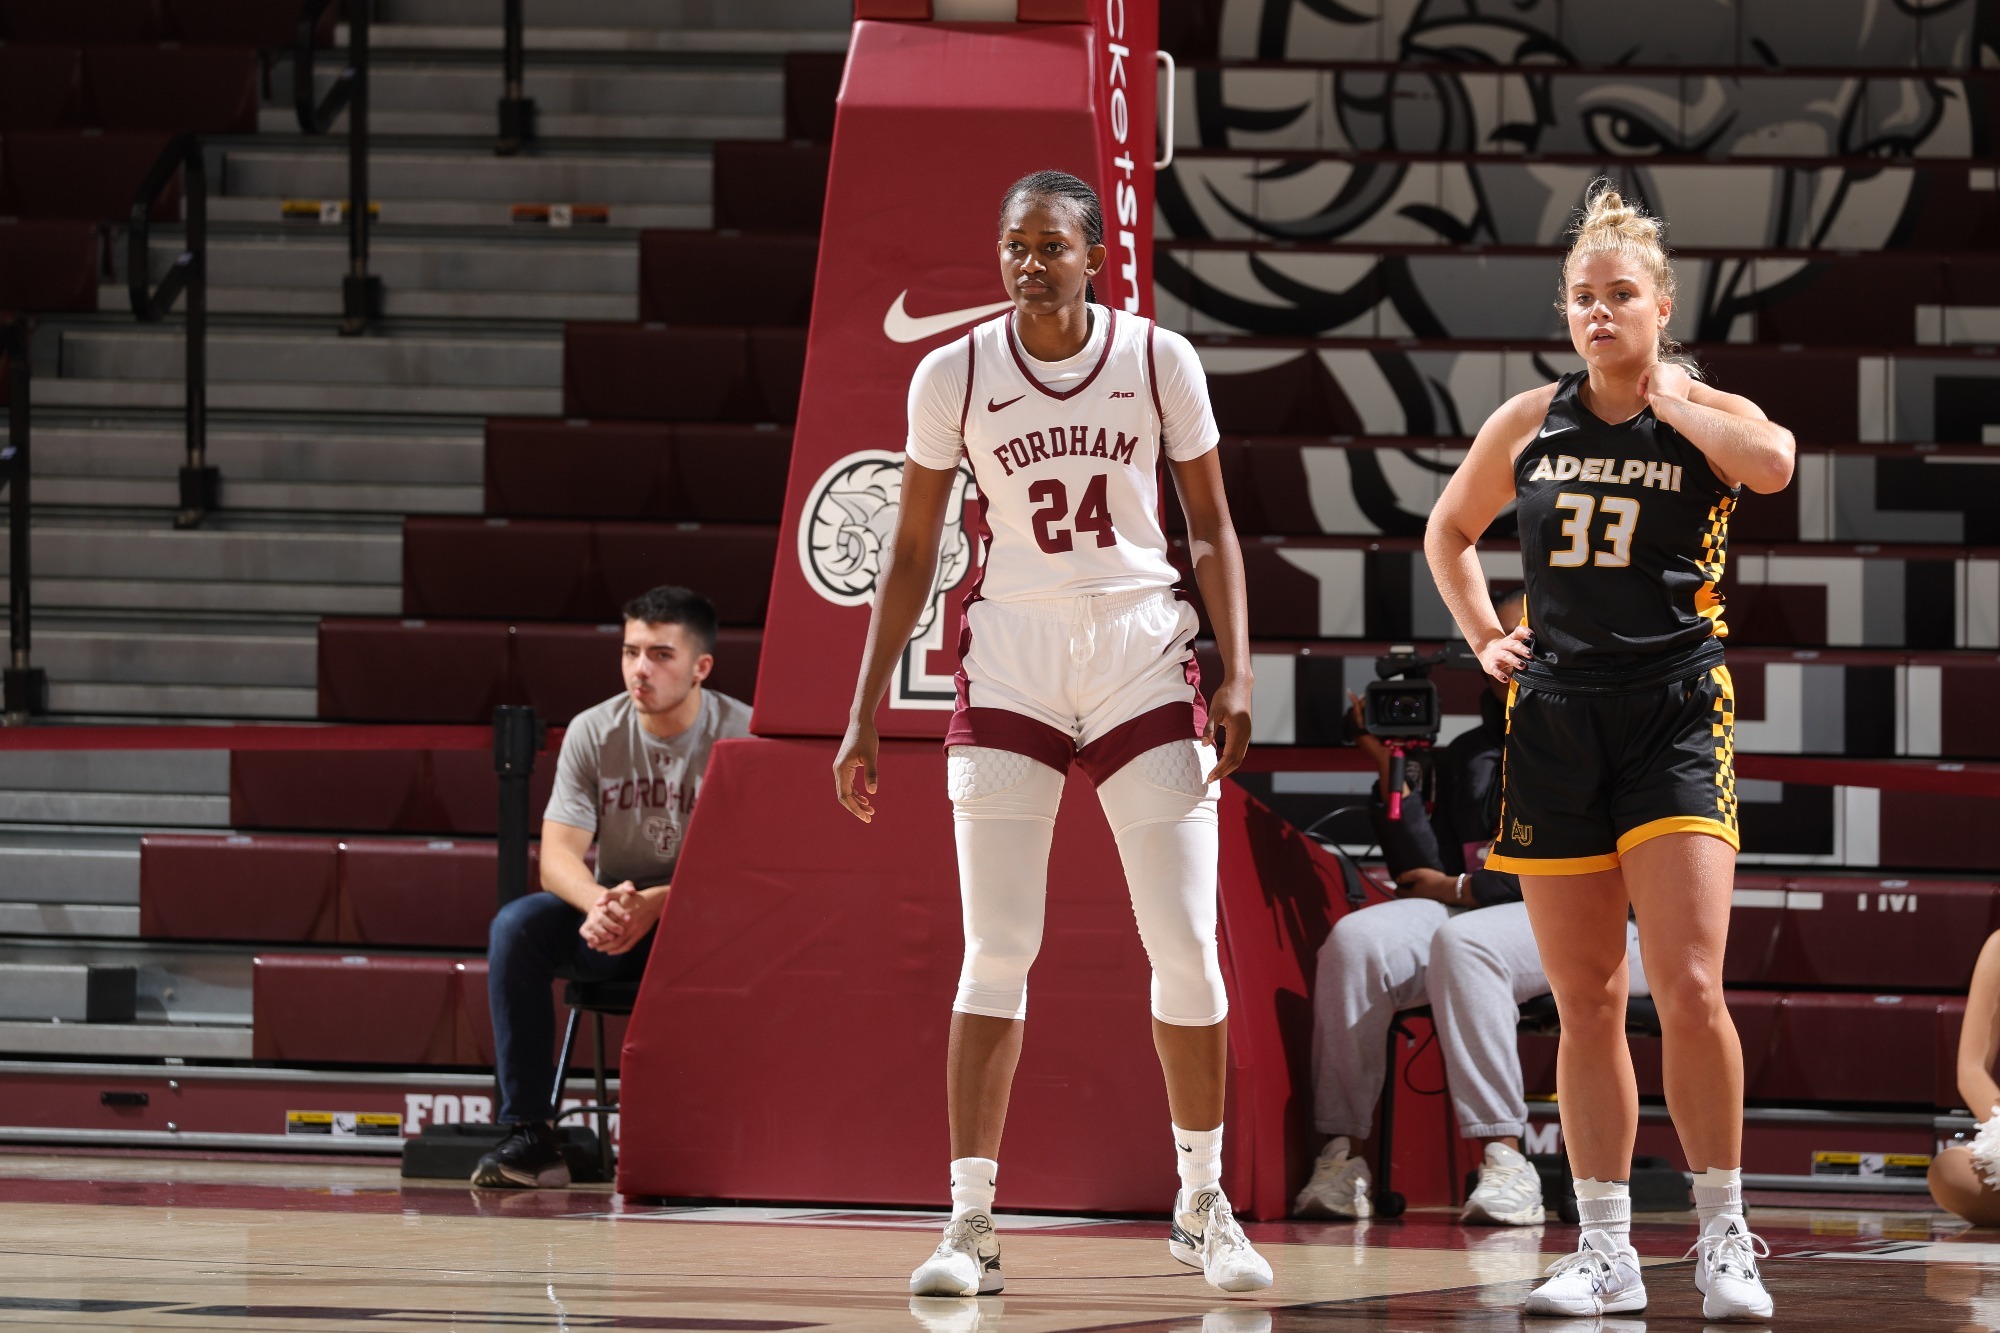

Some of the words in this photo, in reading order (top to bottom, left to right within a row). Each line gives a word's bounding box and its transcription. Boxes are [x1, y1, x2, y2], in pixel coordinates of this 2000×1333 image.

[993, 425, 1139, 477] FORDHAM
[1529, 454, 1682, 492] ADELPHI
[1028, 474, 1117, 554] 24
[1549, 492, 1641, 568] 33
[1512, 817, 1533, 847] AU
